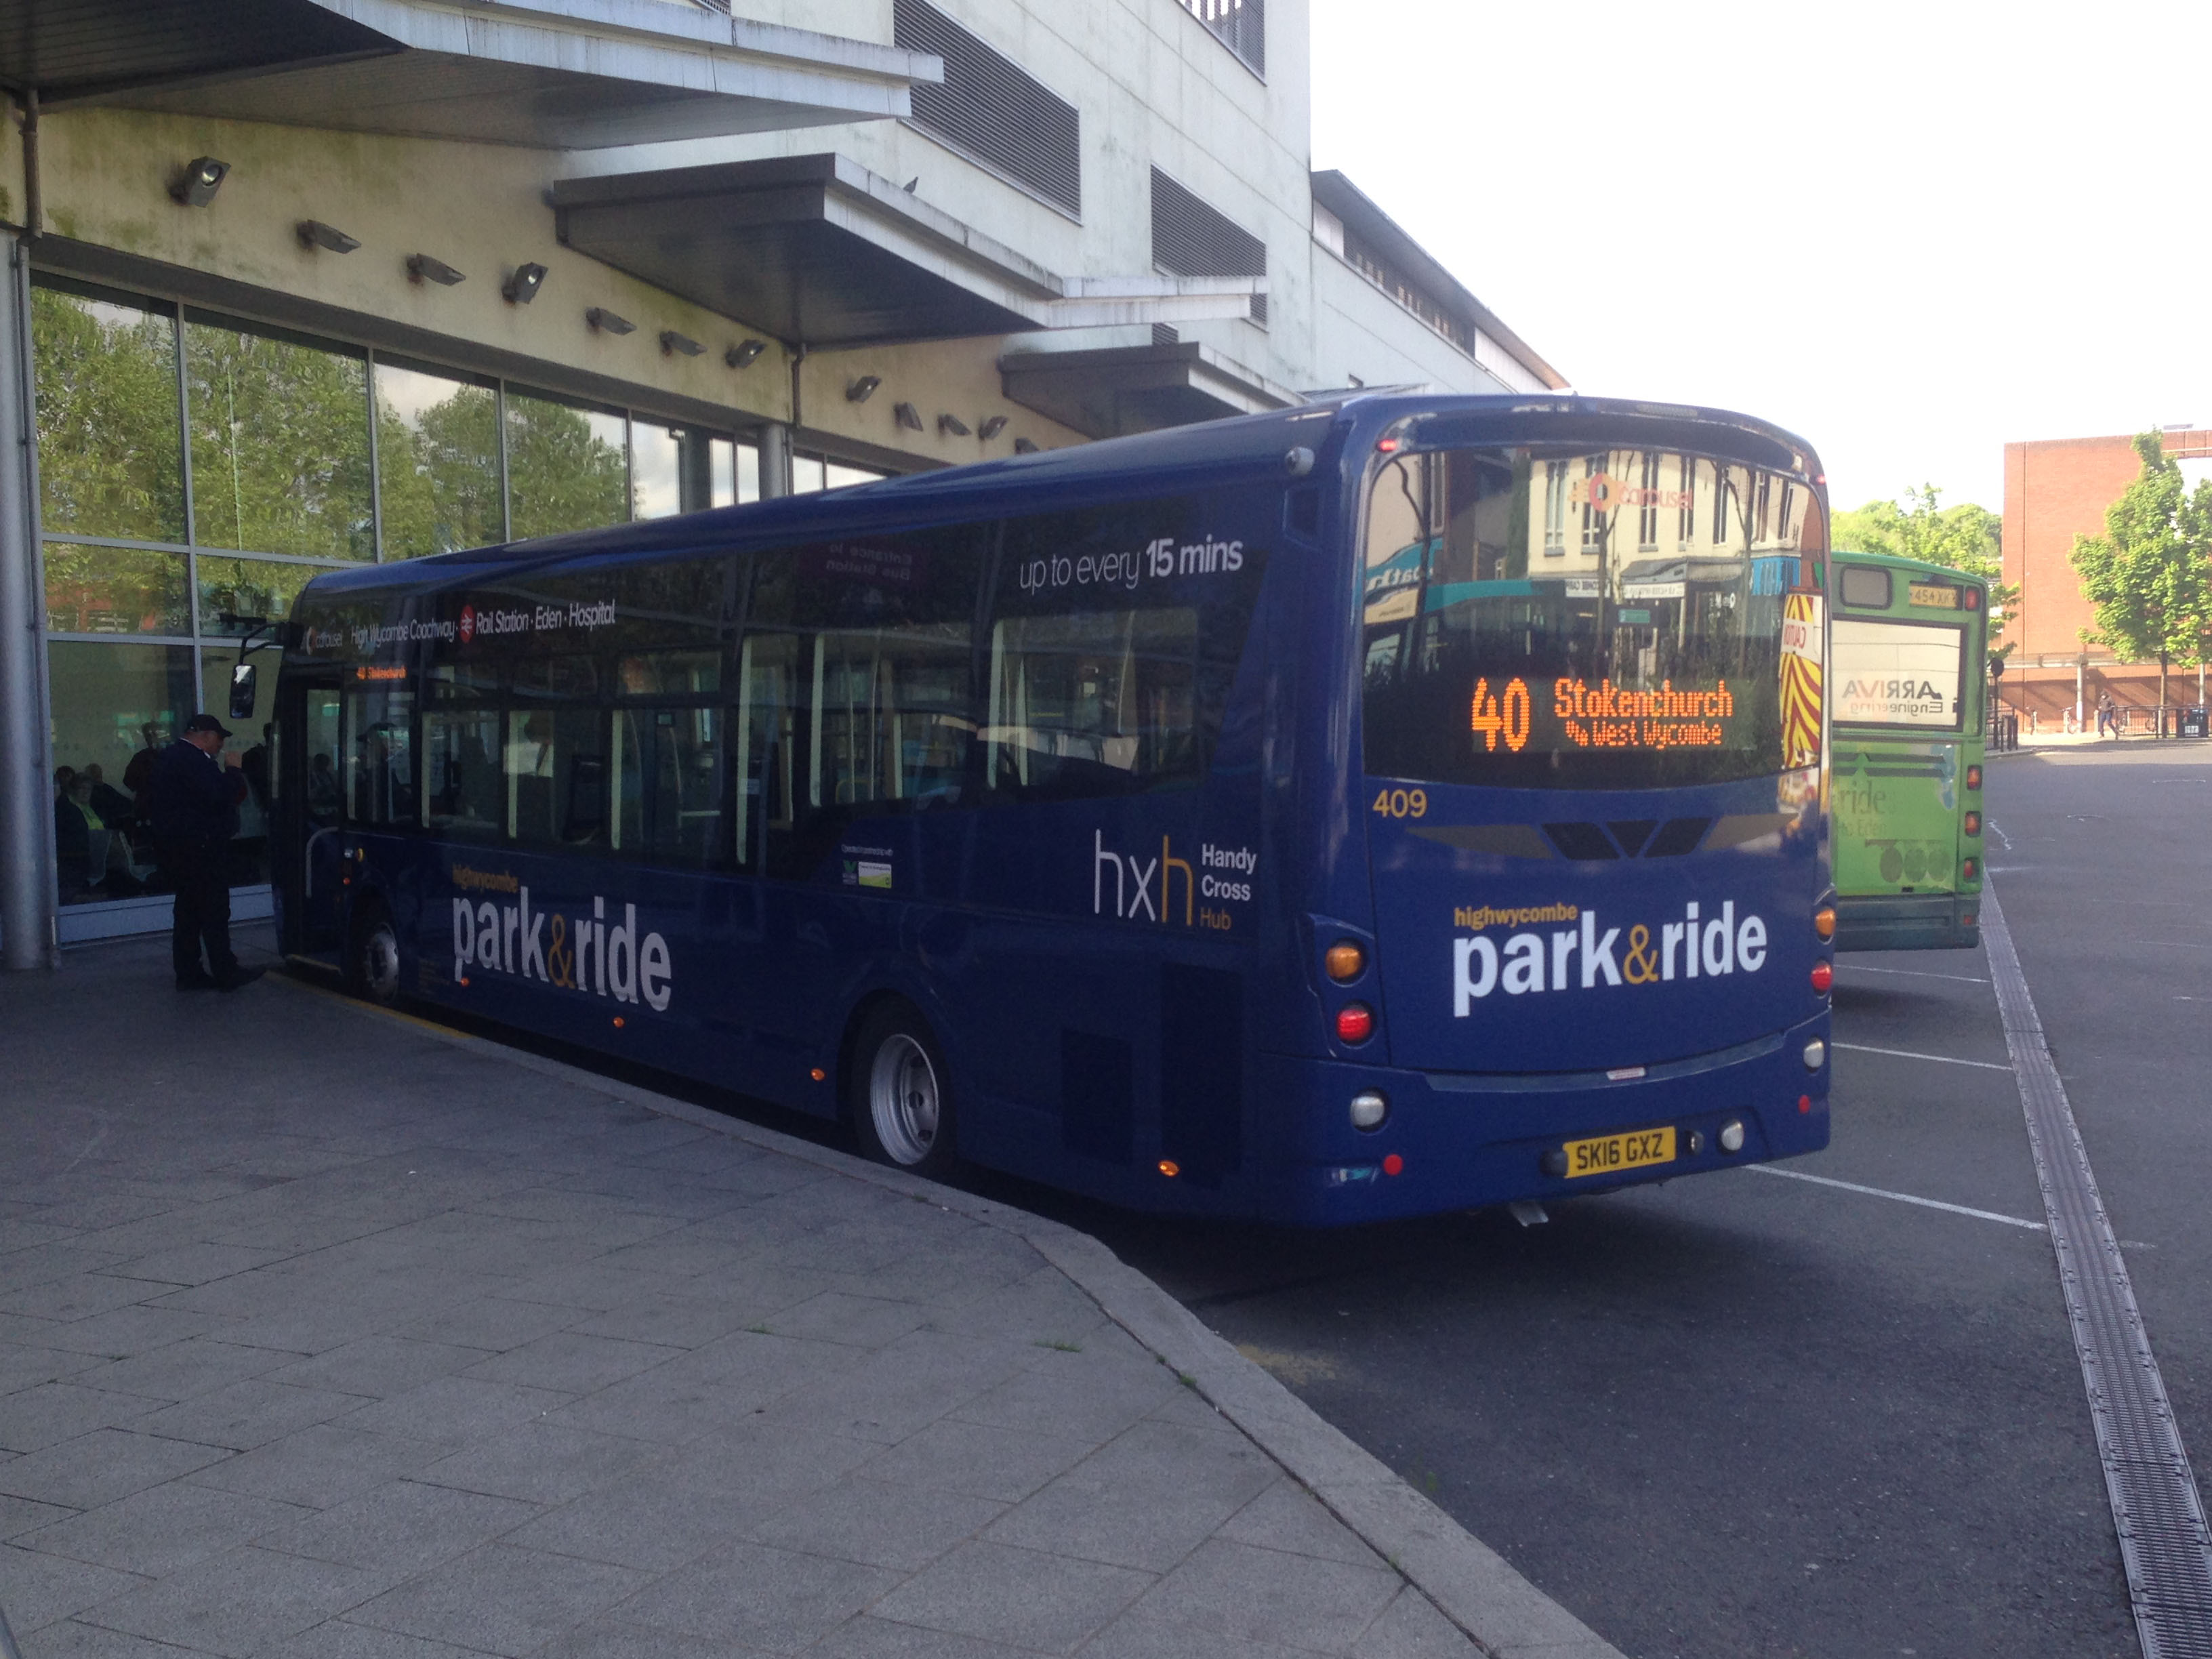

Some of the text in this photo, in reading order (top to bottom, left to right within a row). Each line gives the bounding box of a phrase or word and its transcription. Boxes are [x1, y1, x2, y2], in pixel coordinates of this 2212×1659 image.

[1619, 480, 1694, 510] carousel
[1020, 533, 1244, 595] up to every 15 mins
[476, 598, 615, 634] Rail Station Eden Hospital
[369, 621, 408, 648] Wycombe
[409, 618, 455, 642] Coachway
[1471, 678, 1734, 752] 40 Stokenchurch
[1592, 720, 1639, 746] West
[1643, 720, 1723, 750] Wycombe
[1372, 789, 1427, 818] 409
[1201, 843, 1257, 875] Handy
[1201, 874, 1251, 901] Cross
[1200, 907, 1232, 930] Hub
[1454, 902, 1578, 930] highwycombe
[1576, 1133, 1664, 1170] SK16 GXZ
